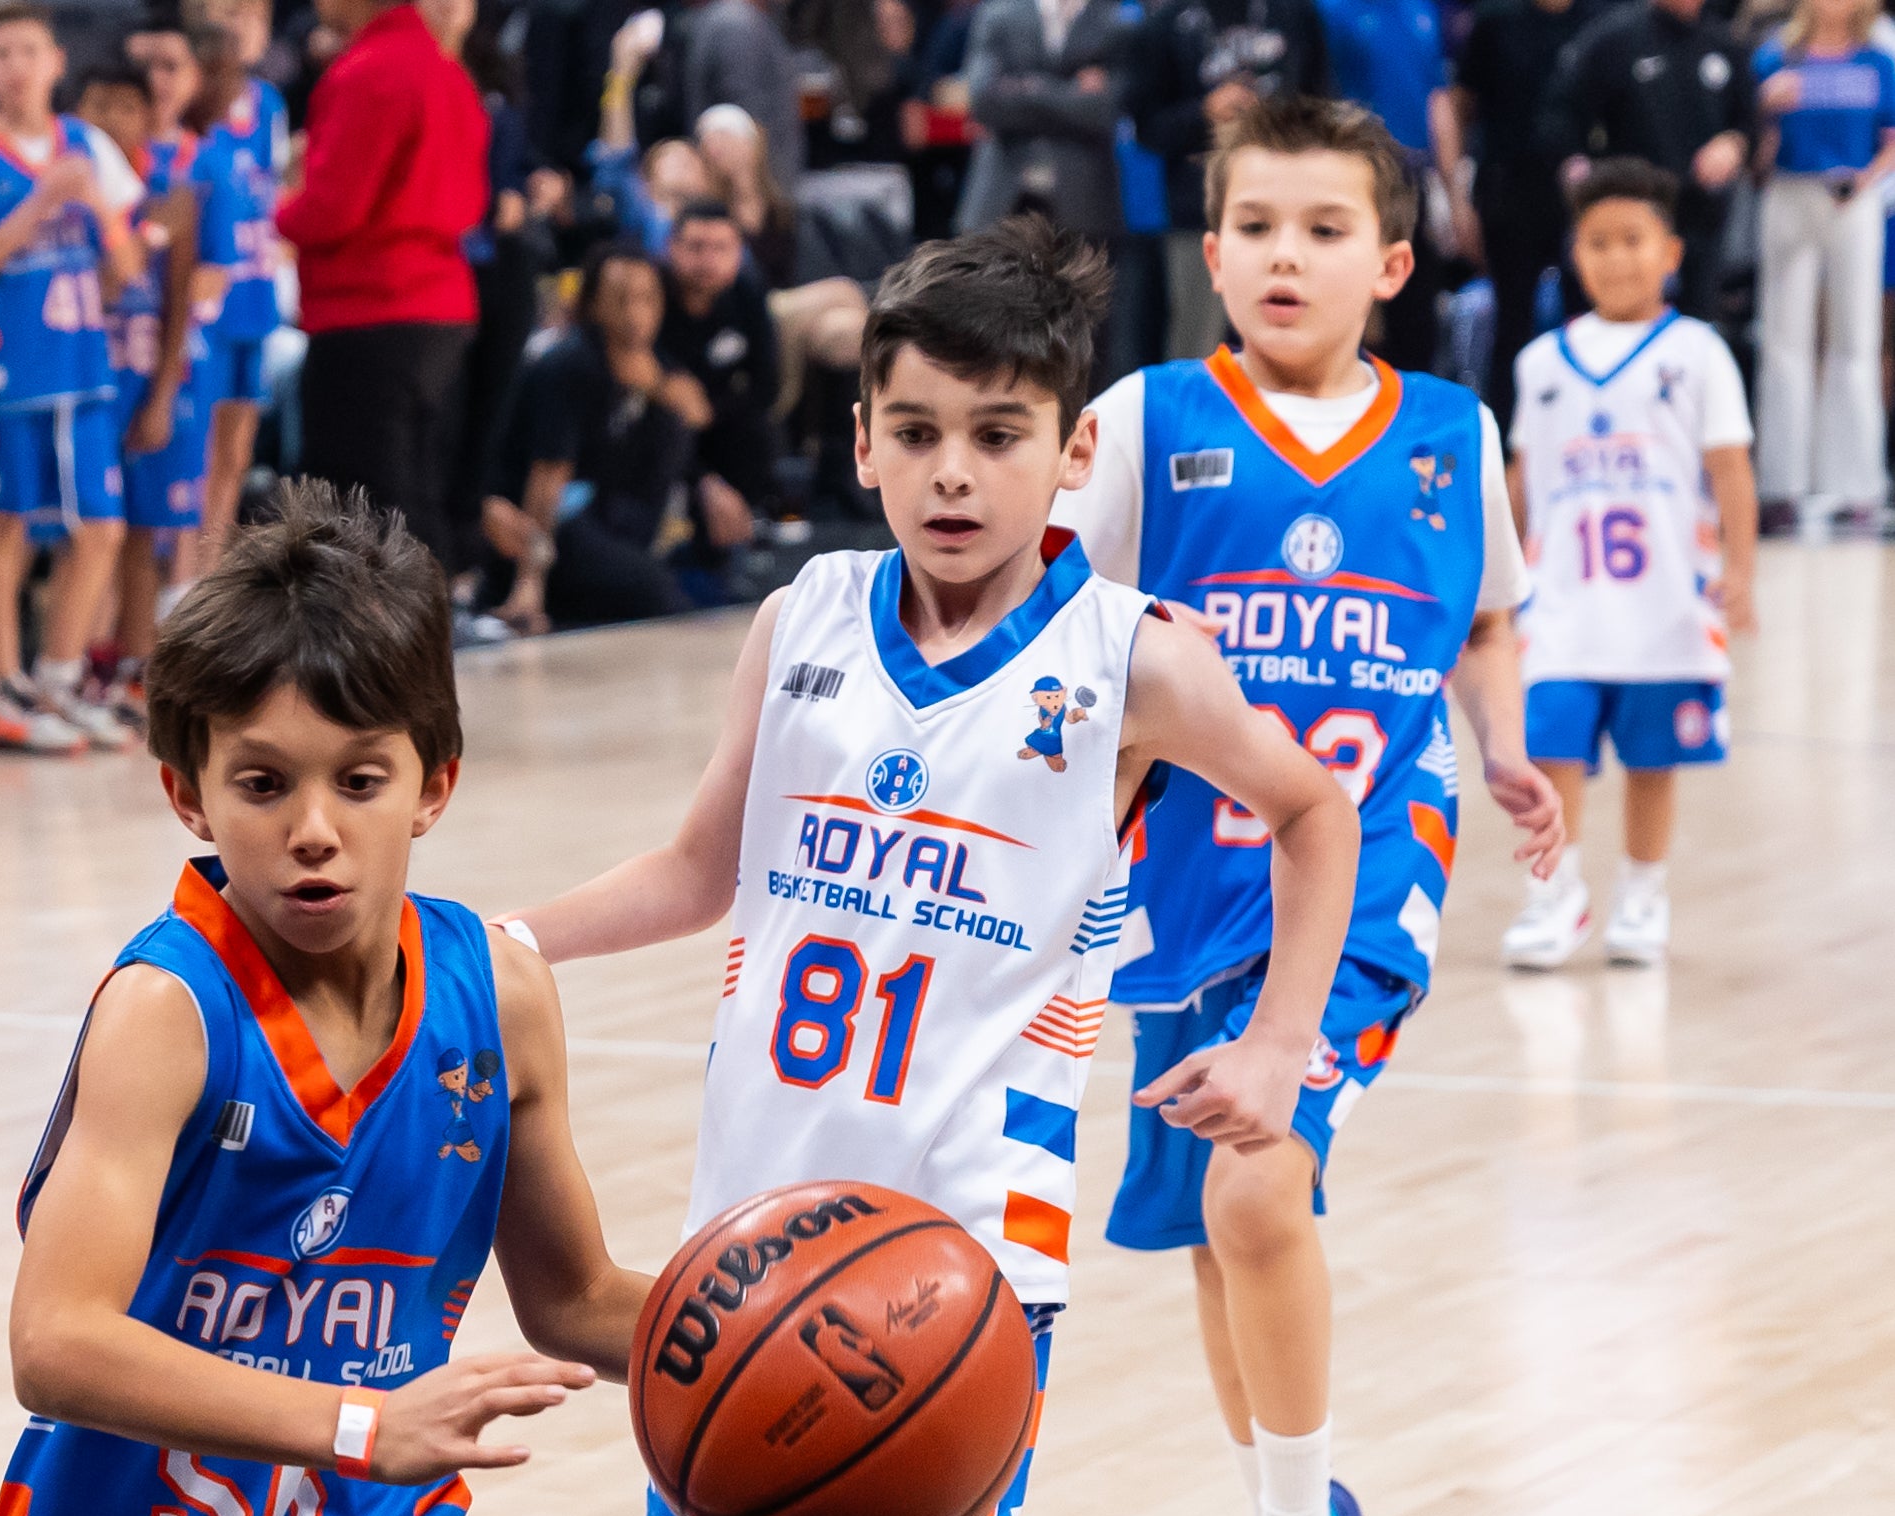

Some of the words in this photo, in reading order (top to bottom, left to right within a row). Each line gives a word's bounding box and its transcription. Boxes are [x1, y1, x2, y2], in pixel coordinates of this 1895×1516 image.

[1576, 507, 1648, 581] 16
[1204, 591, 1407, 662] ROYAL
[1349, 660, 1444, 696] SCHOO
[795, 813, 987, 904] ROYAL
[767, 870, 898, 921] BASKETBALL
[912, 900, 1033, 952] SCHOOL
[769, 932, 936, 1106] 81
[653, 1194, 889, 1387] Wilson
